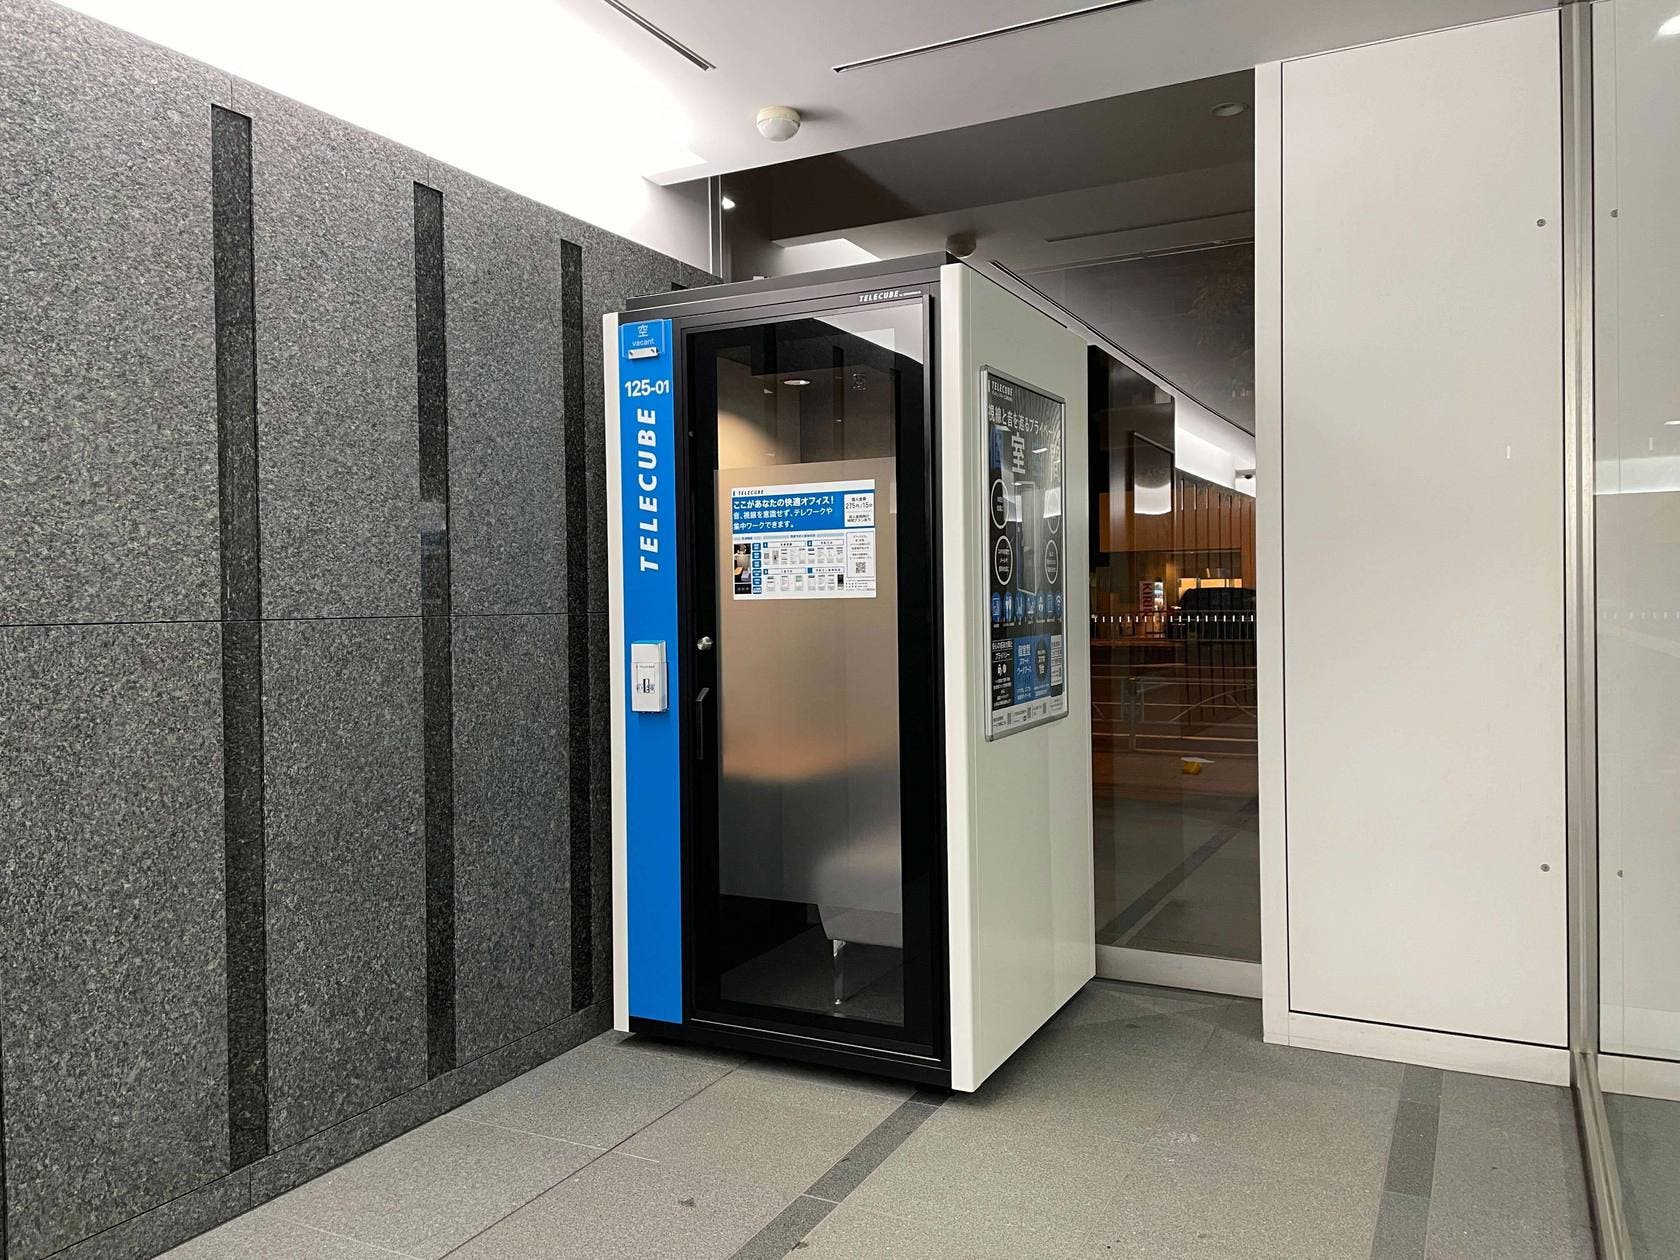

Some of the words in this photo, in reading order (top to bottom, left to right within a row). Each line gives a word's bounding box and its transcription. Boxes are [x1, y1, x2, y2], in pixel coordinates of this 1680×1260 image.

[859, 290, 899, 302] TELECUBE
[637, 324, 649, 337] 空
[631, 337, 655, 347] vacant
[624, 379, 670, 397] 125-01
[991, 380, 1013, 397] TELECUBE
[637, 408, 659, 572] TELECUBE
